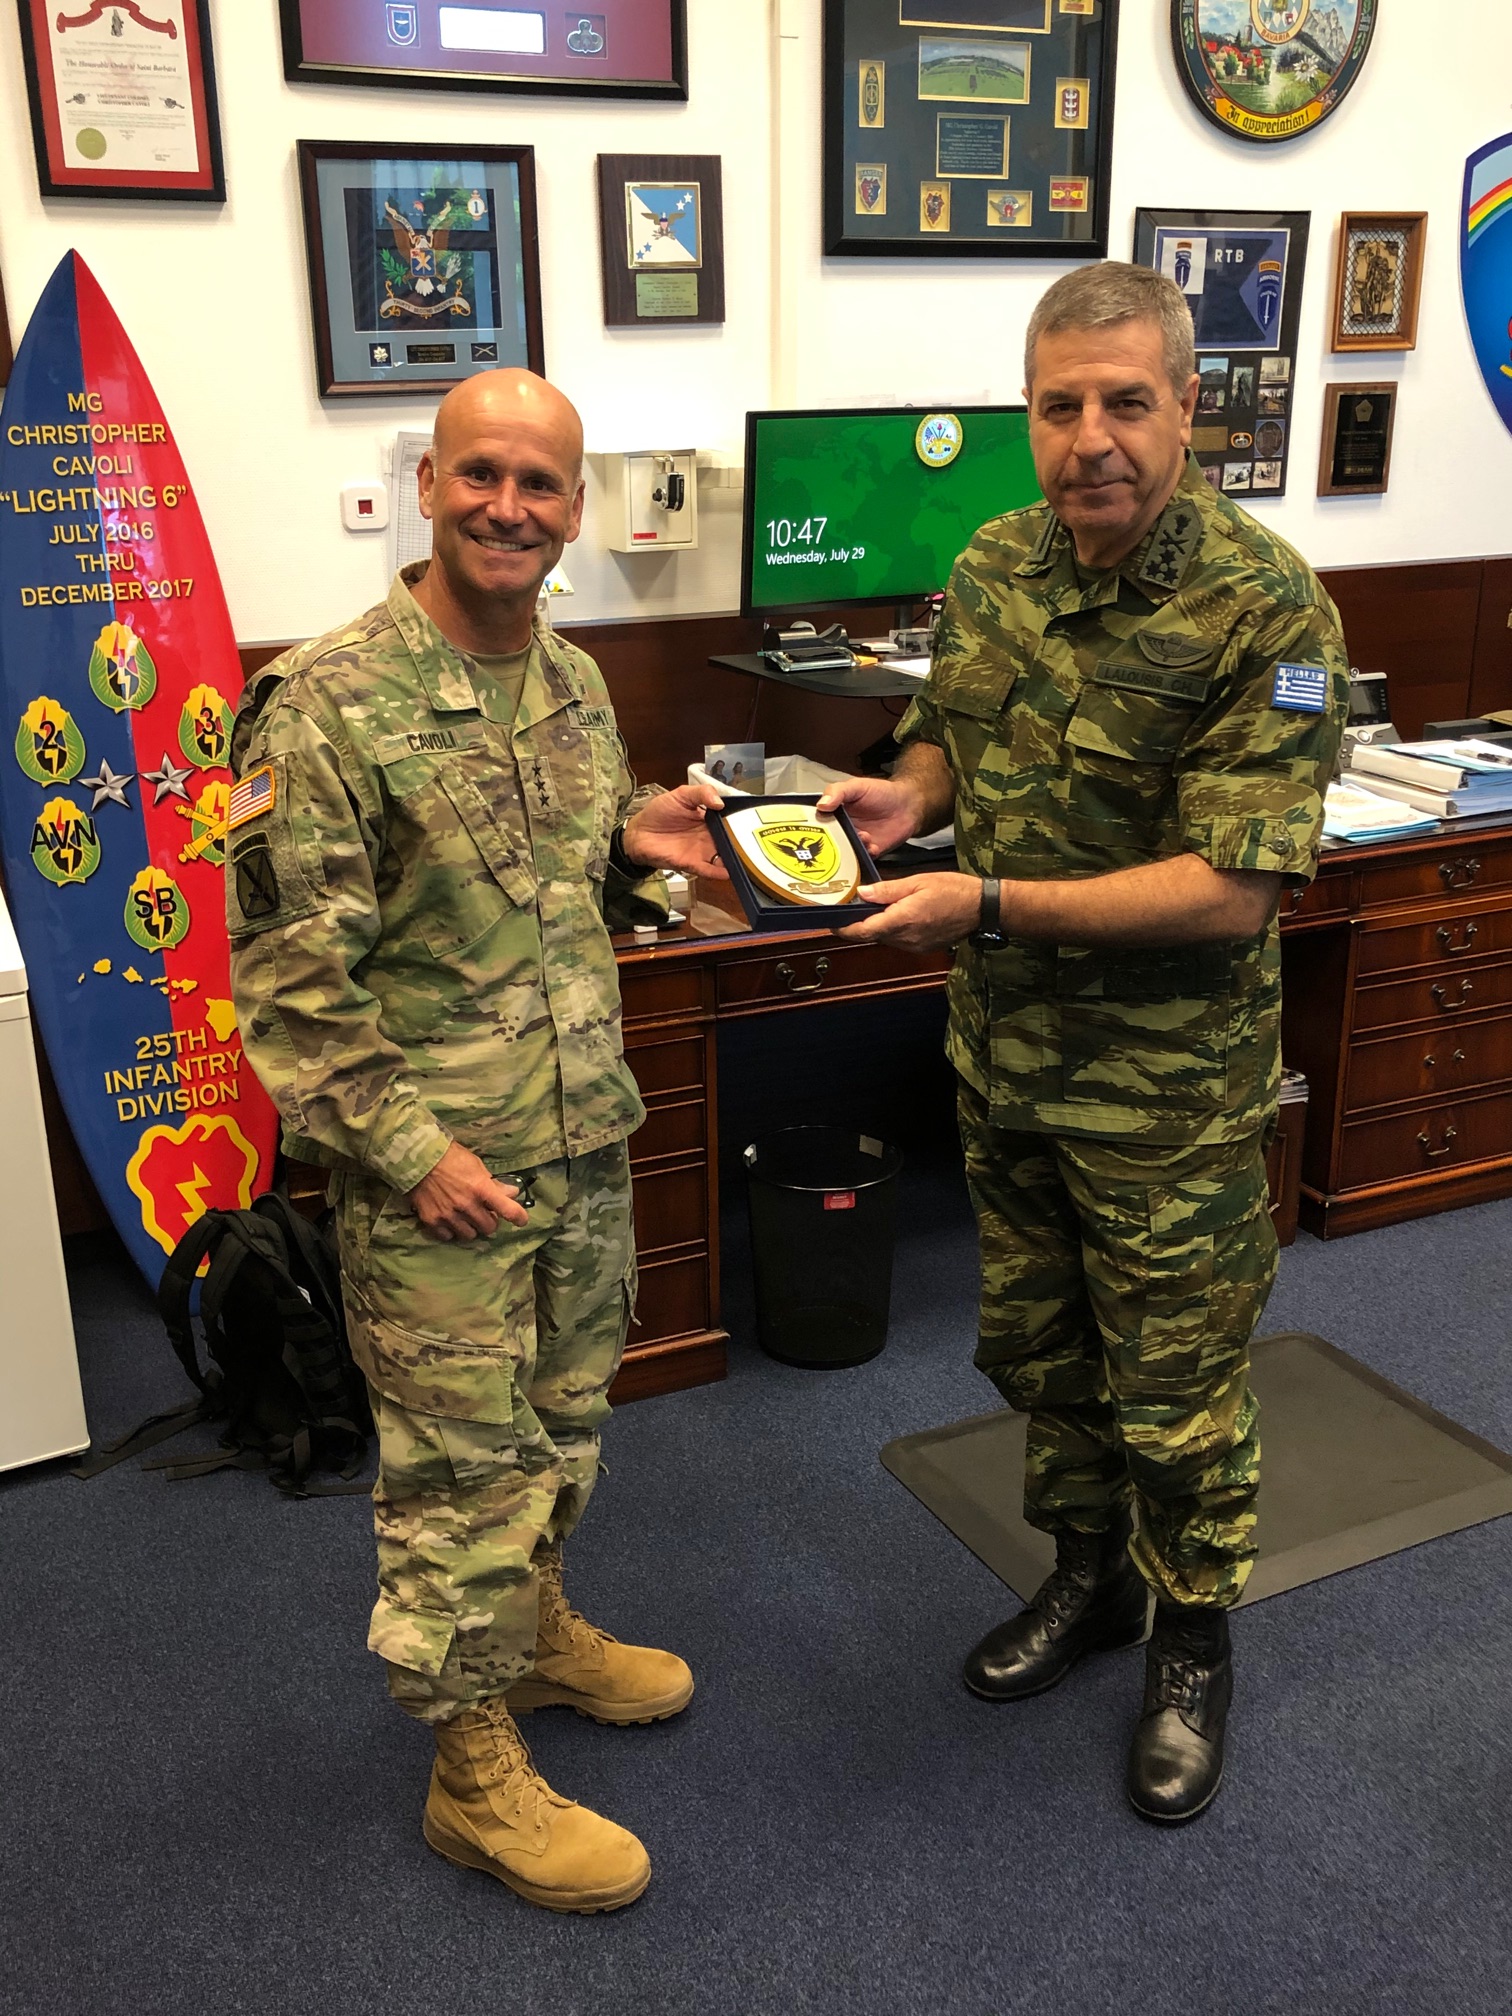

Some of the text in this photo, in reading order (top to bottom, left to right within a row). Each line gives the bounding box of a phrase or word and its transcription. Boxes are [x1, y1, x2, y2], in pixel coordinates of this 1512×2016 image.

[1261, 29, 1290, 41] BAVARIA
[1226, 104, 1309, 134] In appreciation!
[1214, 249, 1244, 263] RTB
[67, 392, 103, 412] MG
[7, 424, 167, 446] CHRISTOPHER
[52, 455, 133, 476] CAVOLI
[49, 522, 154, 544] JULY 2016
[766, 517, 828, 548] 10:47
[75, 552, 135, 573] THRU
[766, 547, 865, 565] Wednesday, July 29
[20, 579, 194, 607] DECEMBER 2017
[1285, 668, 1319, 681] HELLAS
[200, 707, 216, 735] 3
[40, 721, 58, 749] 2
[406, 733, 457, 752] CAVOLI
[29, 817, 97, 854] AVN
[133, 887, 177, 919] SB
[135, 1027, 207, 1060] 25TH
[104, 1049, 243, 1095] INFANTRY
[116, 1079, 239, 1122] DIVISION
